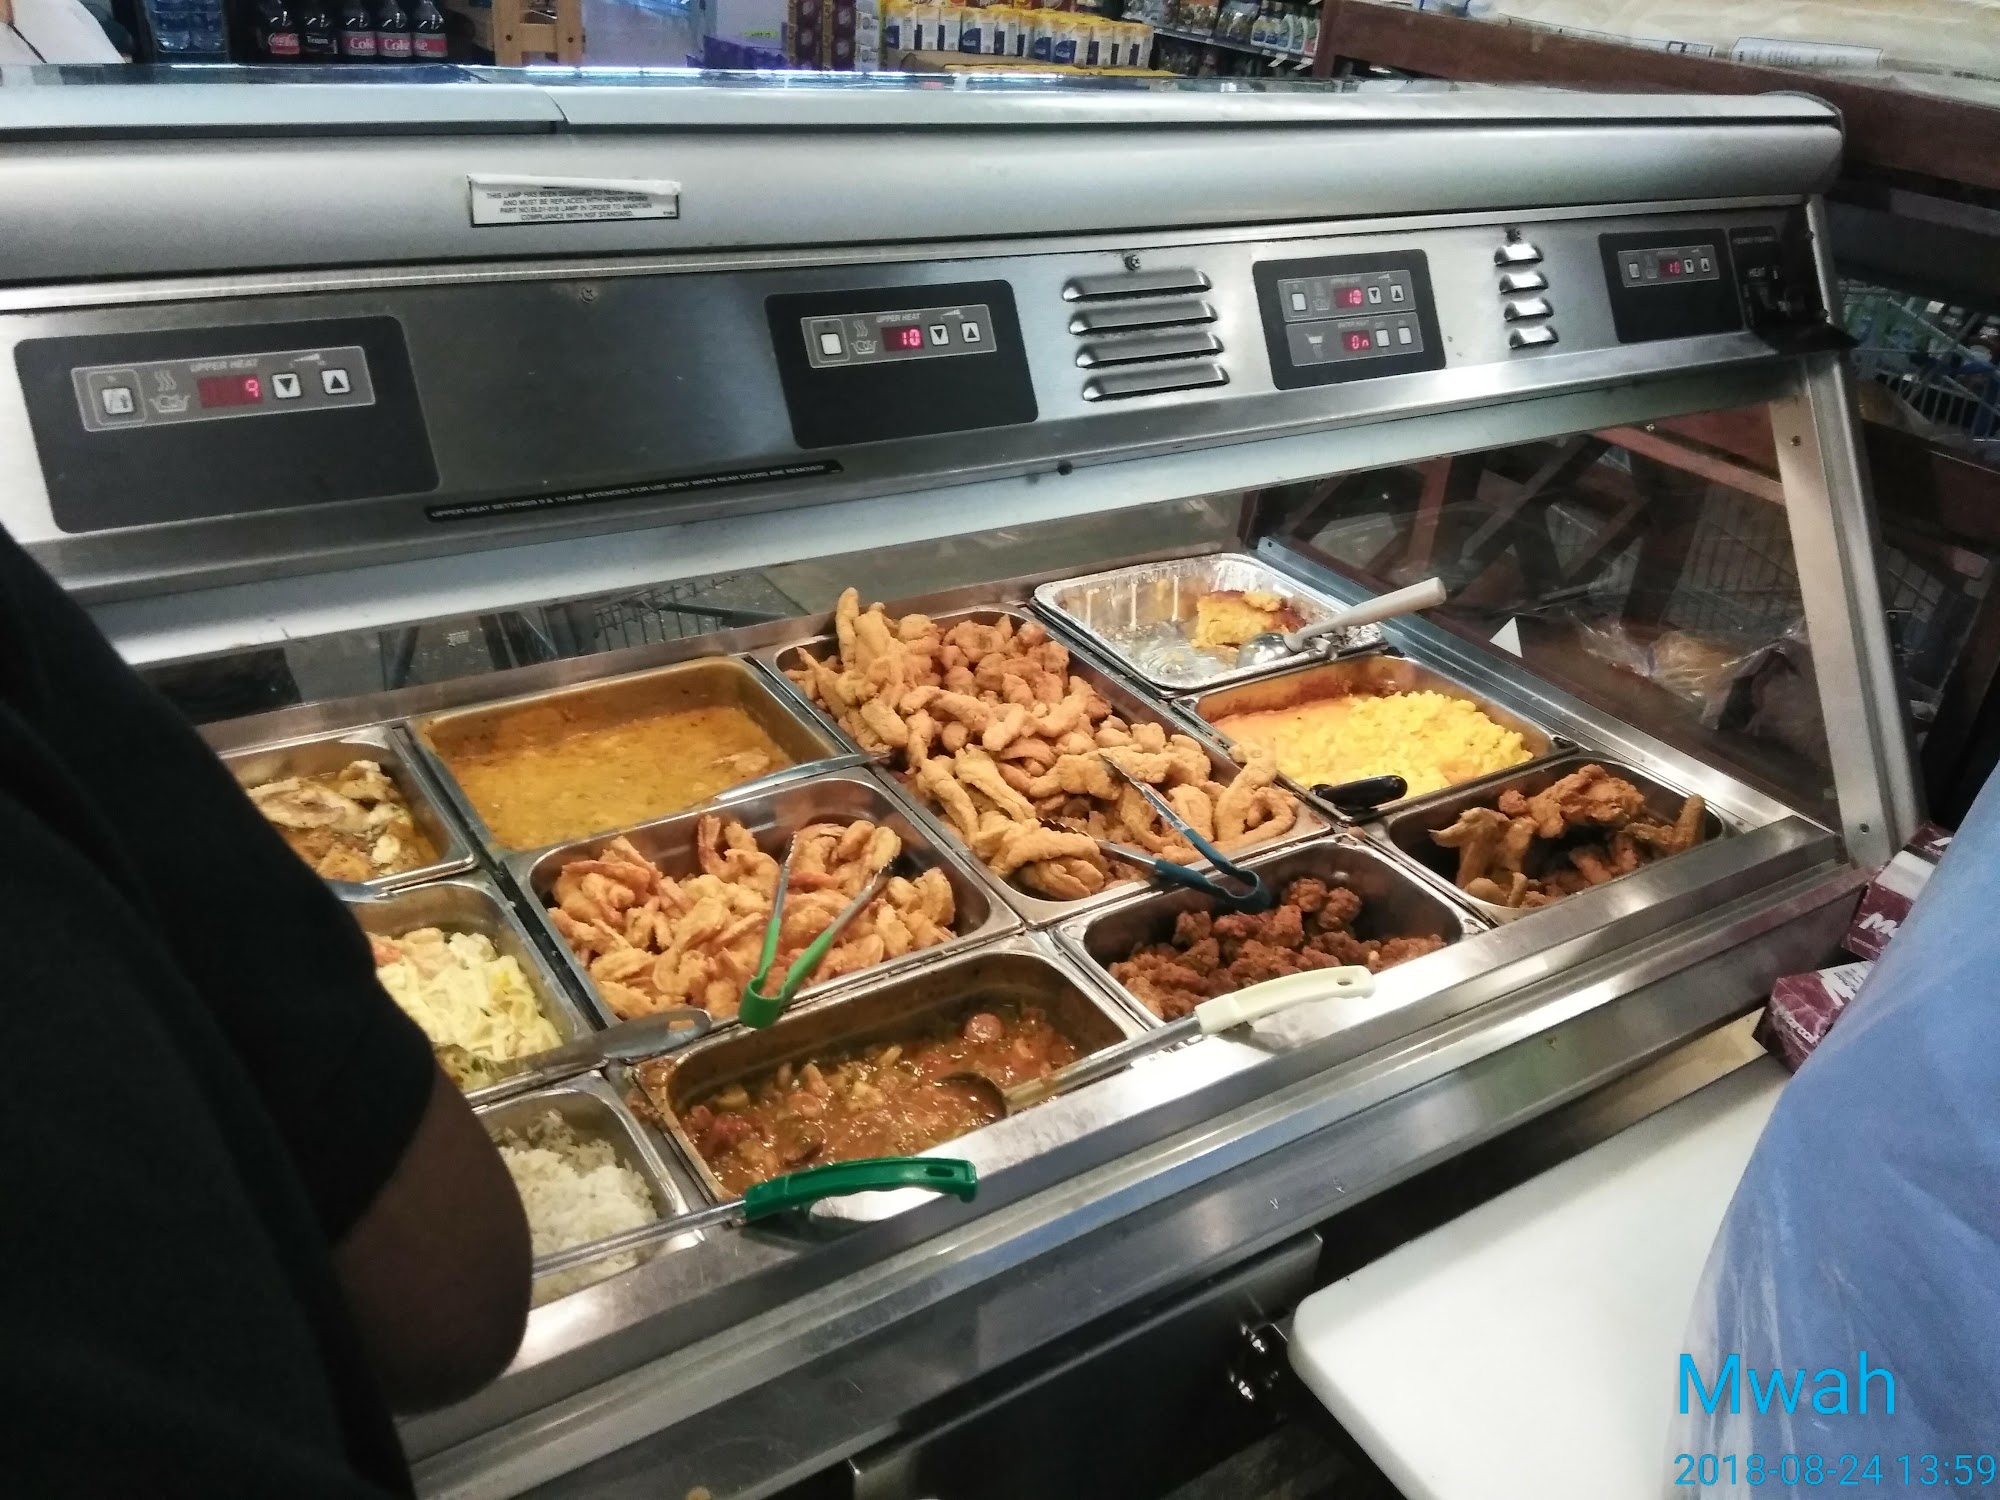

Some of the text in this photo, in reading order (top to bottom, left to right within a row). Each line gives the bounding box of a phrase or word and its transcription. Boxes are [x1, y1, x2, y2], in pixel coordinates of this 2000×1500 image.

[876, 311, 921, 322] UPPER HEAT
[902, 328, 921, 346] 10
[229, 358, 258, 369] HEAT
